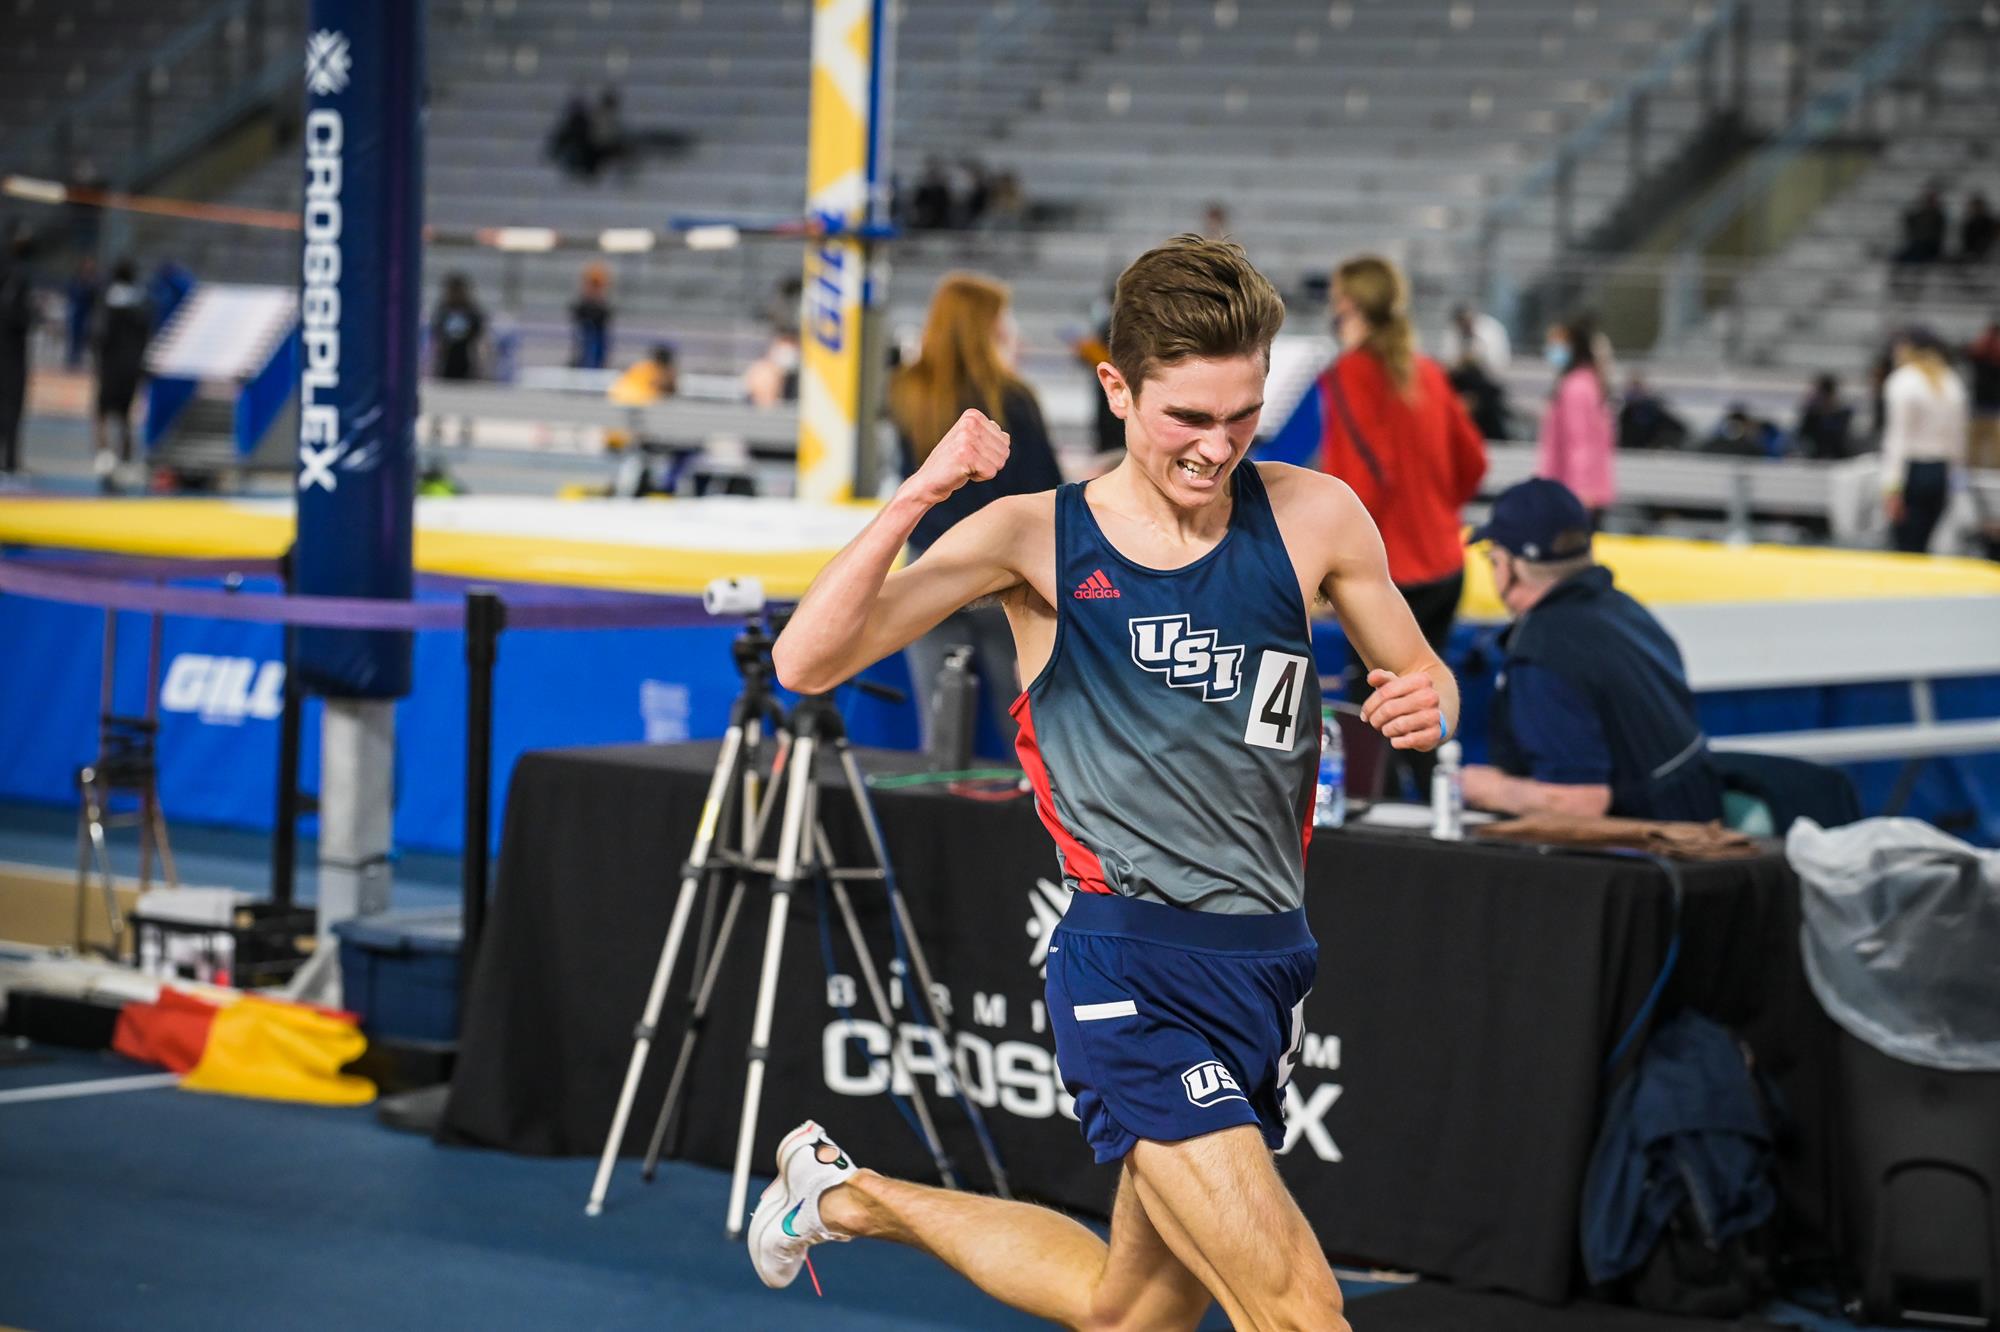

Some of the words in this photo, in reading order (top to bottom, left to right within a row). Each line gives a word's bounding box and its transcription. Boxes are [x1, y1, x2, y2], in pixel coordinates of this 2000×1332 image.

[299, 108, 343, 492] CROSSPLEX
[1073, 587, 1120, 600] adidas
[1131, 617, 1243, 698] USI
[1259, 661, 1298, 744] 4
[1186, 1064, 1242, 1100] US
